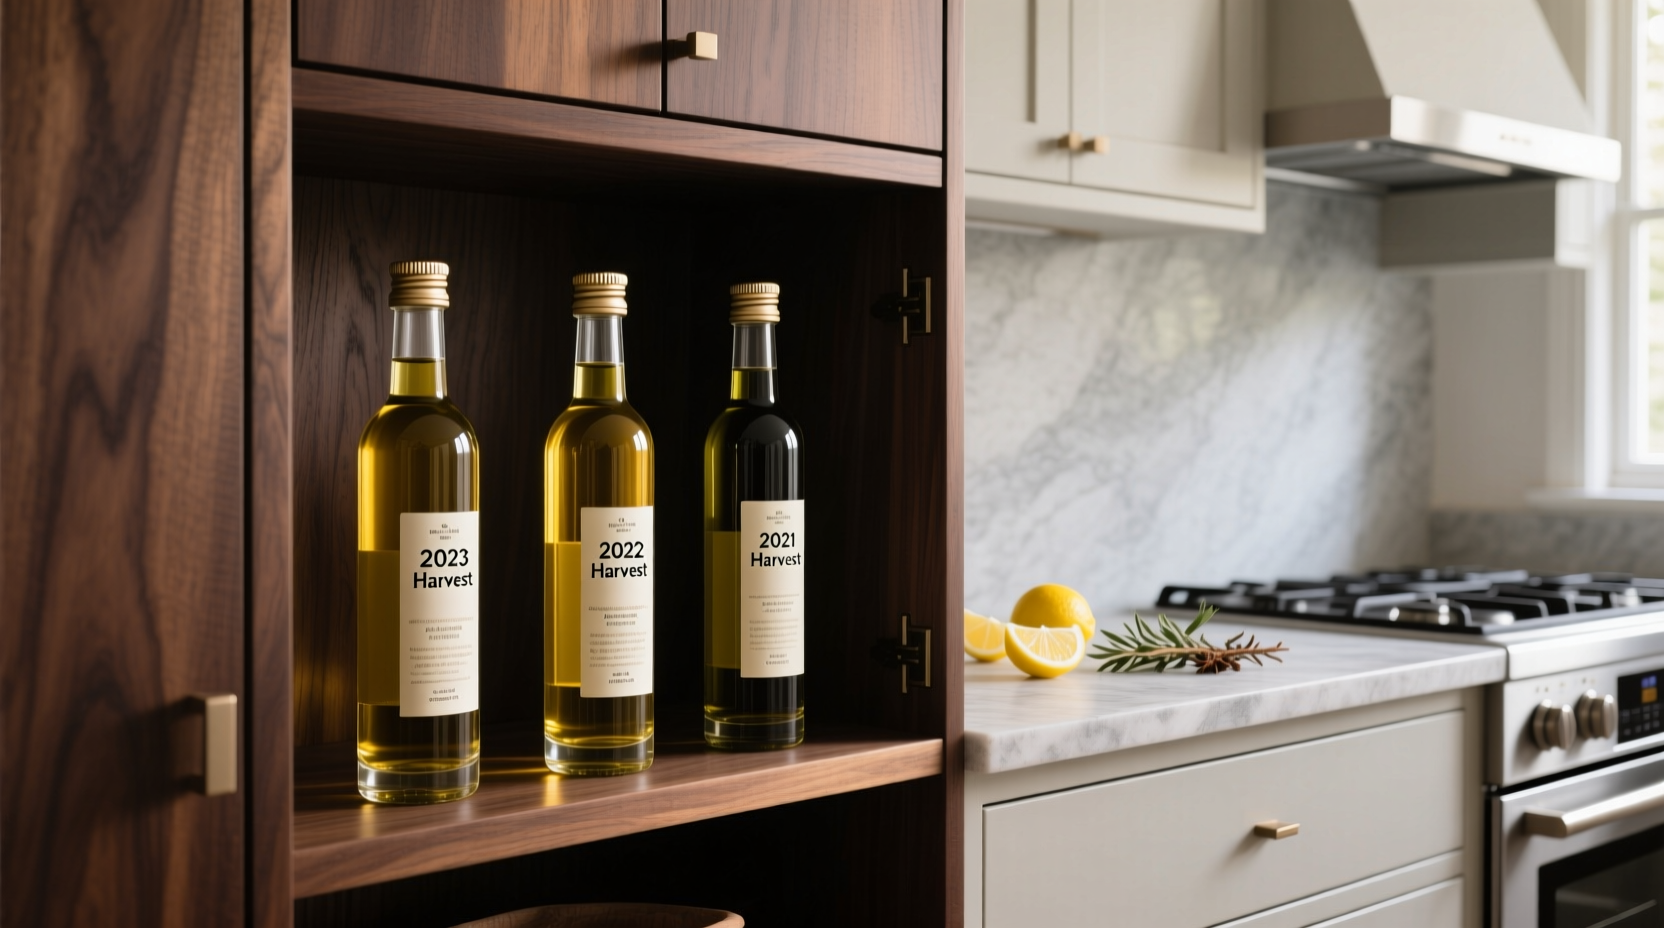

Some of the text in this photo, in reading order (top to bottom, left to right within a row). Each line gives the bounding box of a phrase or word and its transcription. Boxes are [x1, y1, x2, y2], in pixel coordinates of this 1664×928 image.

[759, 532, 795, 549] 2021
[420, 549, 468, 568] 2023
[599, 541, 644, 559] 2022
[751, 552, 801, 567] Harvest
[591, 562, 647, 578] Harvest
[413, 572, 473, 589] Harvest
